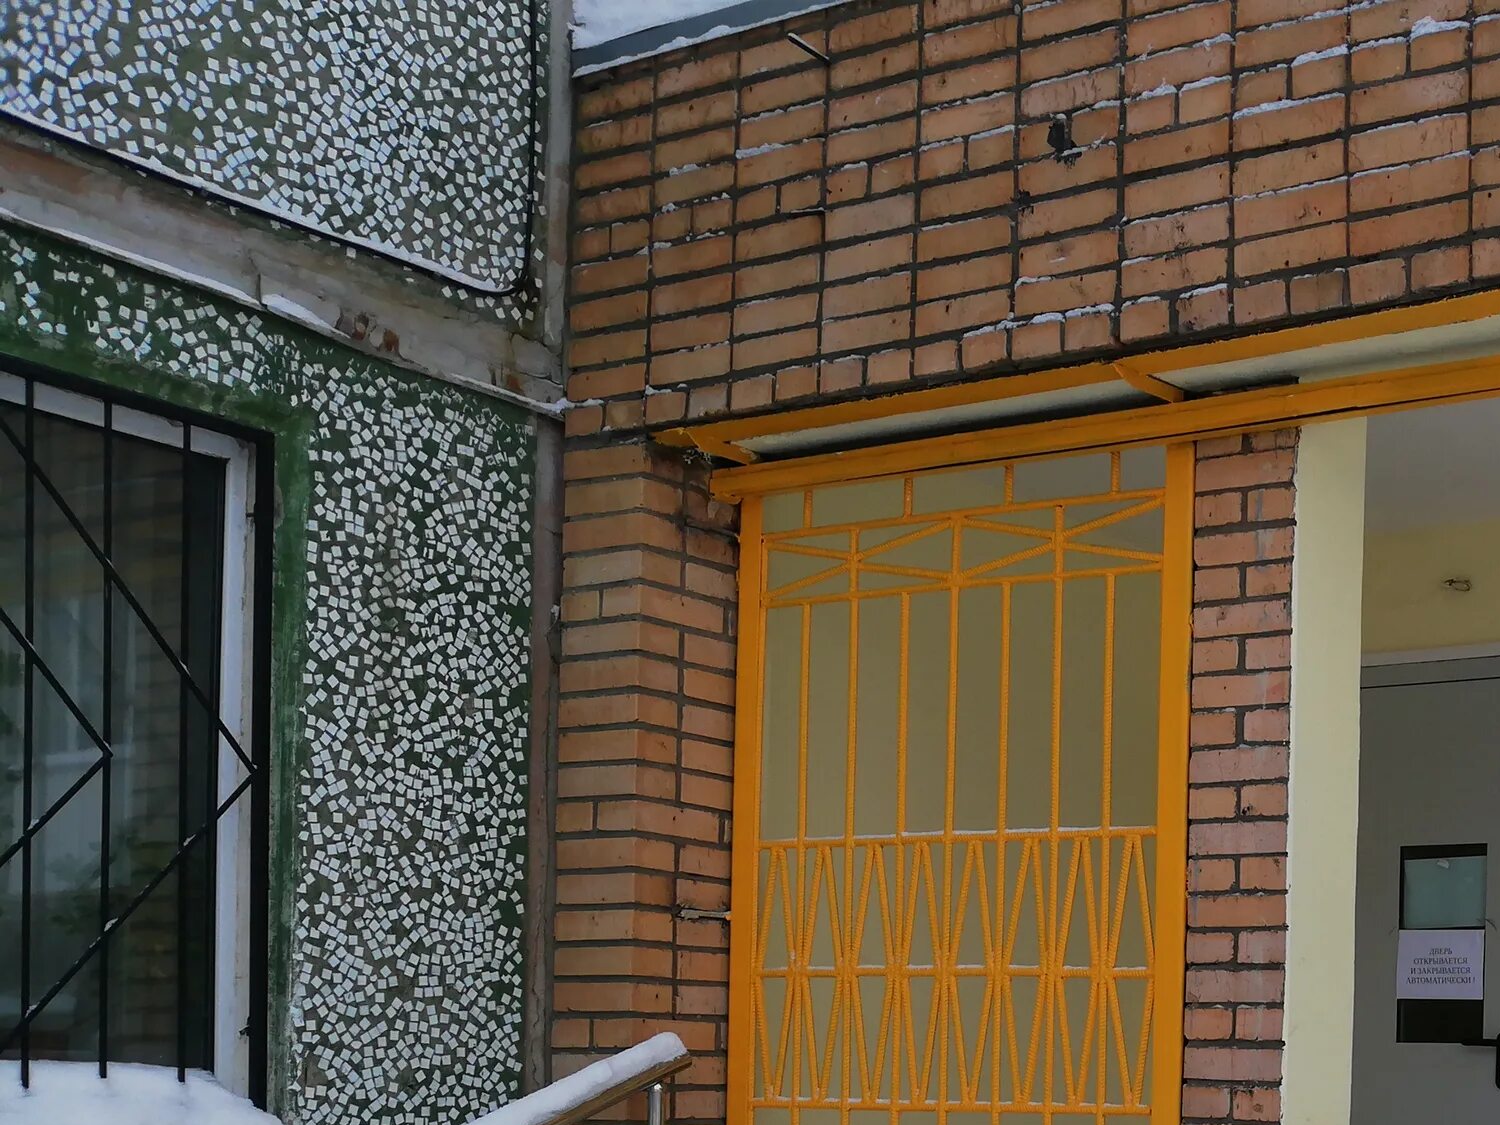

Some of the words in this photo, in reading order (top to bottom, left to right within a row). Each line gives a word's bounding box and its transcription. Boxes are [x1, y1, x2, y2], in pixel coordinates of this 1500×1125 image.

[1429, 948, 1453, 956] ДВЕРЬ
[1413, 957, 1468, 965] ОТКРЫВАЕТСЯ
[1417, 967, 1472, 975] ЗАКРЫВАЕТСЯ
